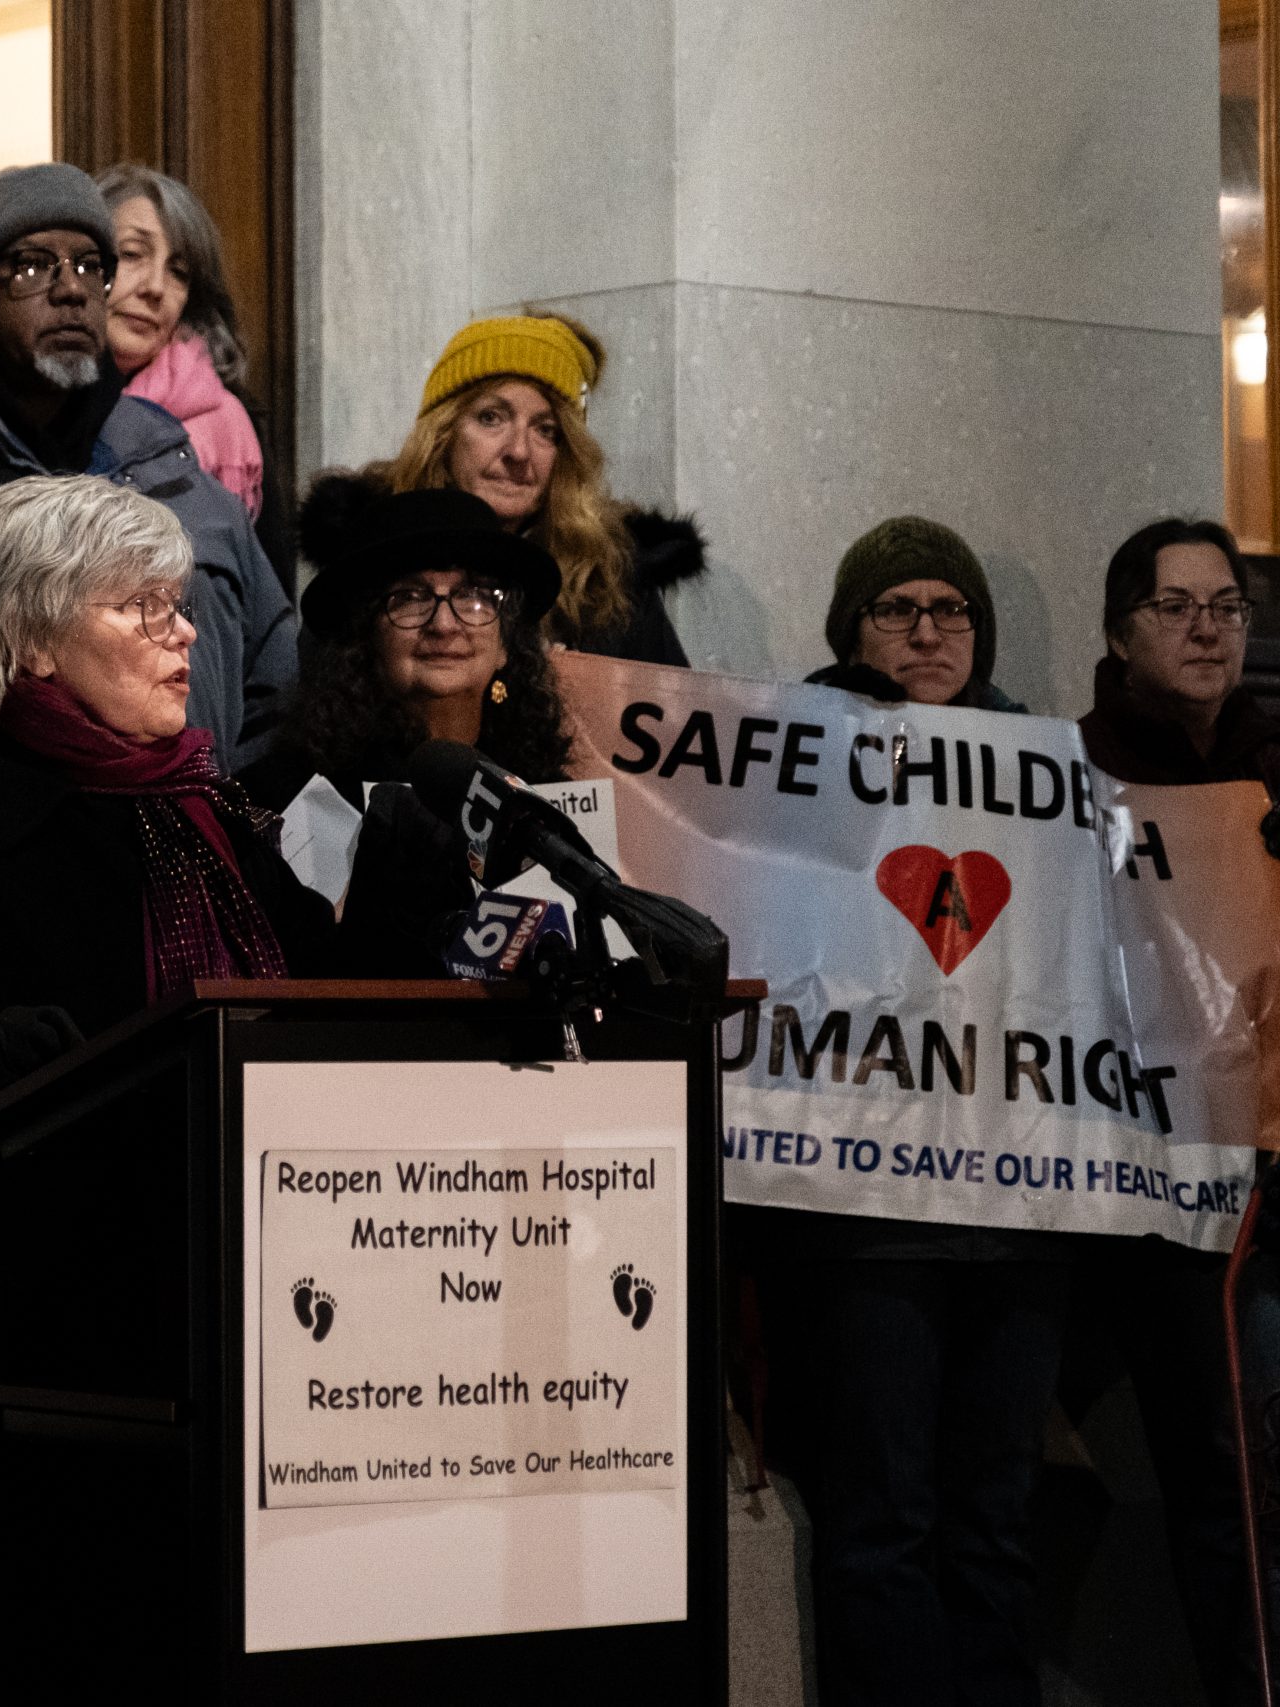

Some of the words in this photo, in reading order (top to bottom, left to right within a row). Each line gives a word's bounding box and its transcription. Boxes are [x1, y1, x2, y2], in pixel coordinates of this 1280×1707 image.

[611, 701, 825, 797] SAFE
[924, 869, 973, 932] A
[462, 900, 522, 958] 61
[501, 904, 543, 965] NEWS
[722, 1002, 977, 1095] UMAN
[278, 1161, 382, 1203] Reopen
[396, 1160, 528, 1193] Windham
[542, 1158, 655, 1200] Hospital
[832, 1137, 882, 1173] TO
[891, 1143, 985, 1183] SAVE
[995, 1153, 1074, 1191] OUR
[350, 1217, 497, 1257] Maternity
[511, 1216, 571, 1246] Unit
[440, 1271, 502, 1303] Now
[308, 1378, 423, 1411] Restore
[438, 1372, 529, 1406] health
[543, 1371, 629, 1411] equity
[269, 1461, 358, 1485] Windham
[366, 1456, 431, 1480] United
[440, 1456, 460, 1477] to
[470, 1455, 516, 1476] Save
[525, 1451, 561, 1473] Our
[569, 1447, 675, 1471] Healthcare
